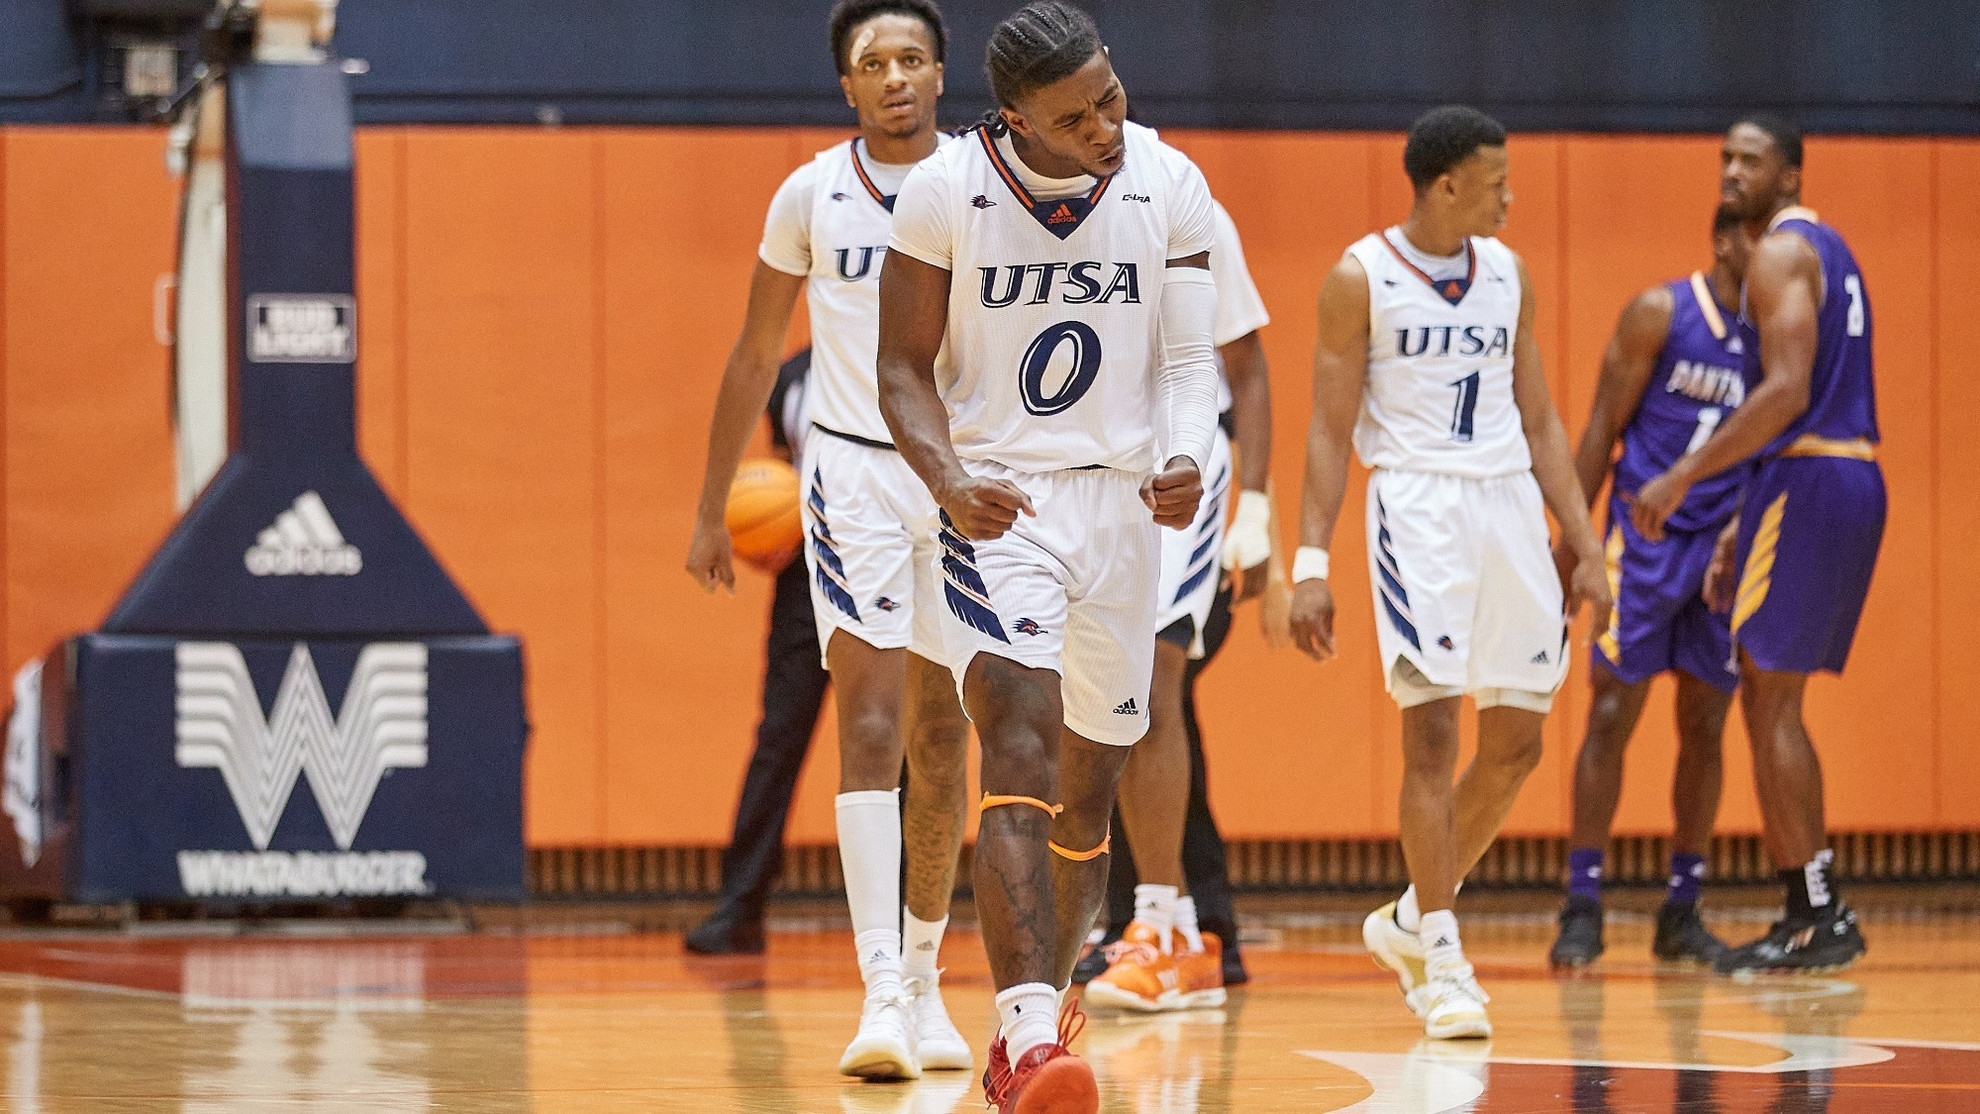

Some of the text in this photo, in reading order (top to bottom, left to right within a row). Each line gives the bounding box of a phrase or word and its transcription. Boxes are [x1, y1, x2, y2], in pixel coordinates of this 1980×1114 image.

[977, 261, 1142, 308] UTSA
[1395, 325, 1508, 358] UTSA
[1019, 320, 1101, 416] 0
[1449, 371, 1479, 441] 1
[243, 544, 363, 576] adidas
[177, 850, 430, 896] WHATABURGER
